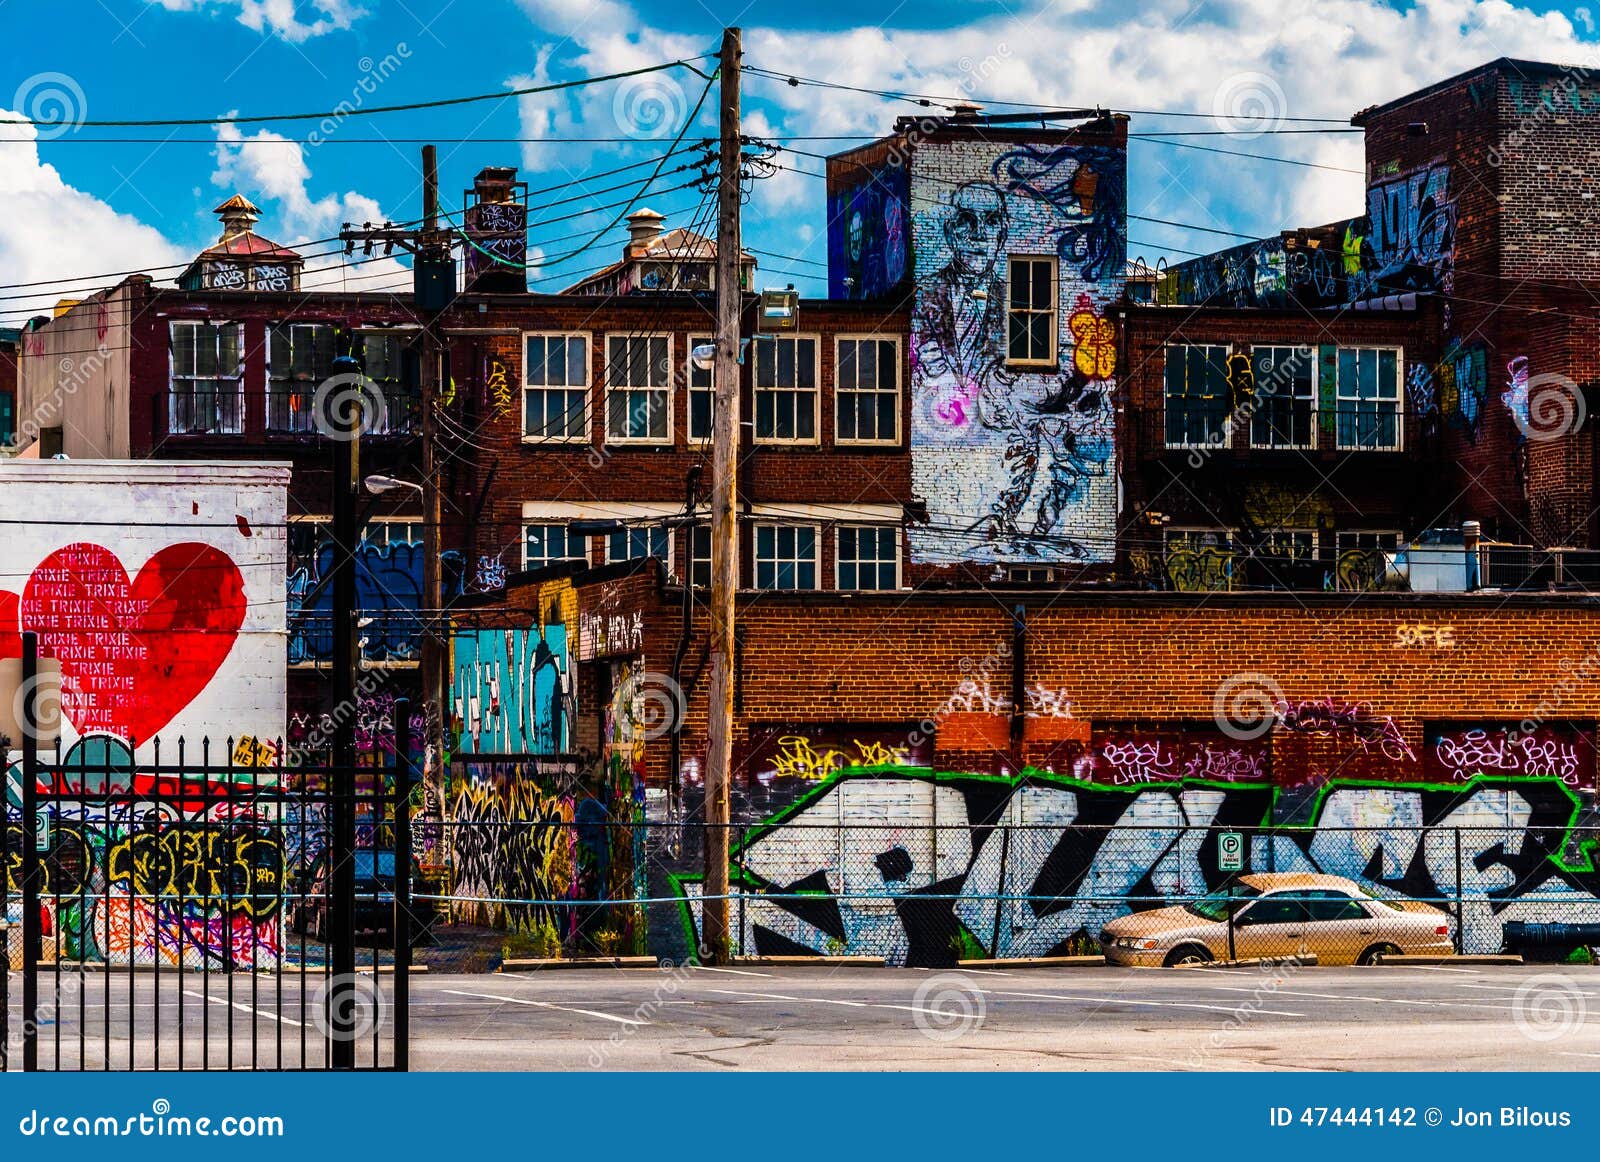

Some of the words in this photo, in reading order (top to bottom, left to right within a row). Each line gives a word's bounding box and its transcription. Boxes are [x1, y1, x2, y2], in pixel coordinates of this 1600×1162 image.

[84, 584, 129, 597] TRIXIE
[50, 600, 95, 613] TRIXIE
[105, 600, 149, 614] TRIXIE
[64, 616, 109, 629] TRIXIE
[86, 632, 130, 646] TRIXIE
[52, 646, 96, 660] TRIXIE
[103, 646, 148, 660] TRIXIE
[70, 662, 115, 674] TRIXIE
[90, 677, 135, 690] TRIXIE
[68, 709, 113, 723] TRIXIE
